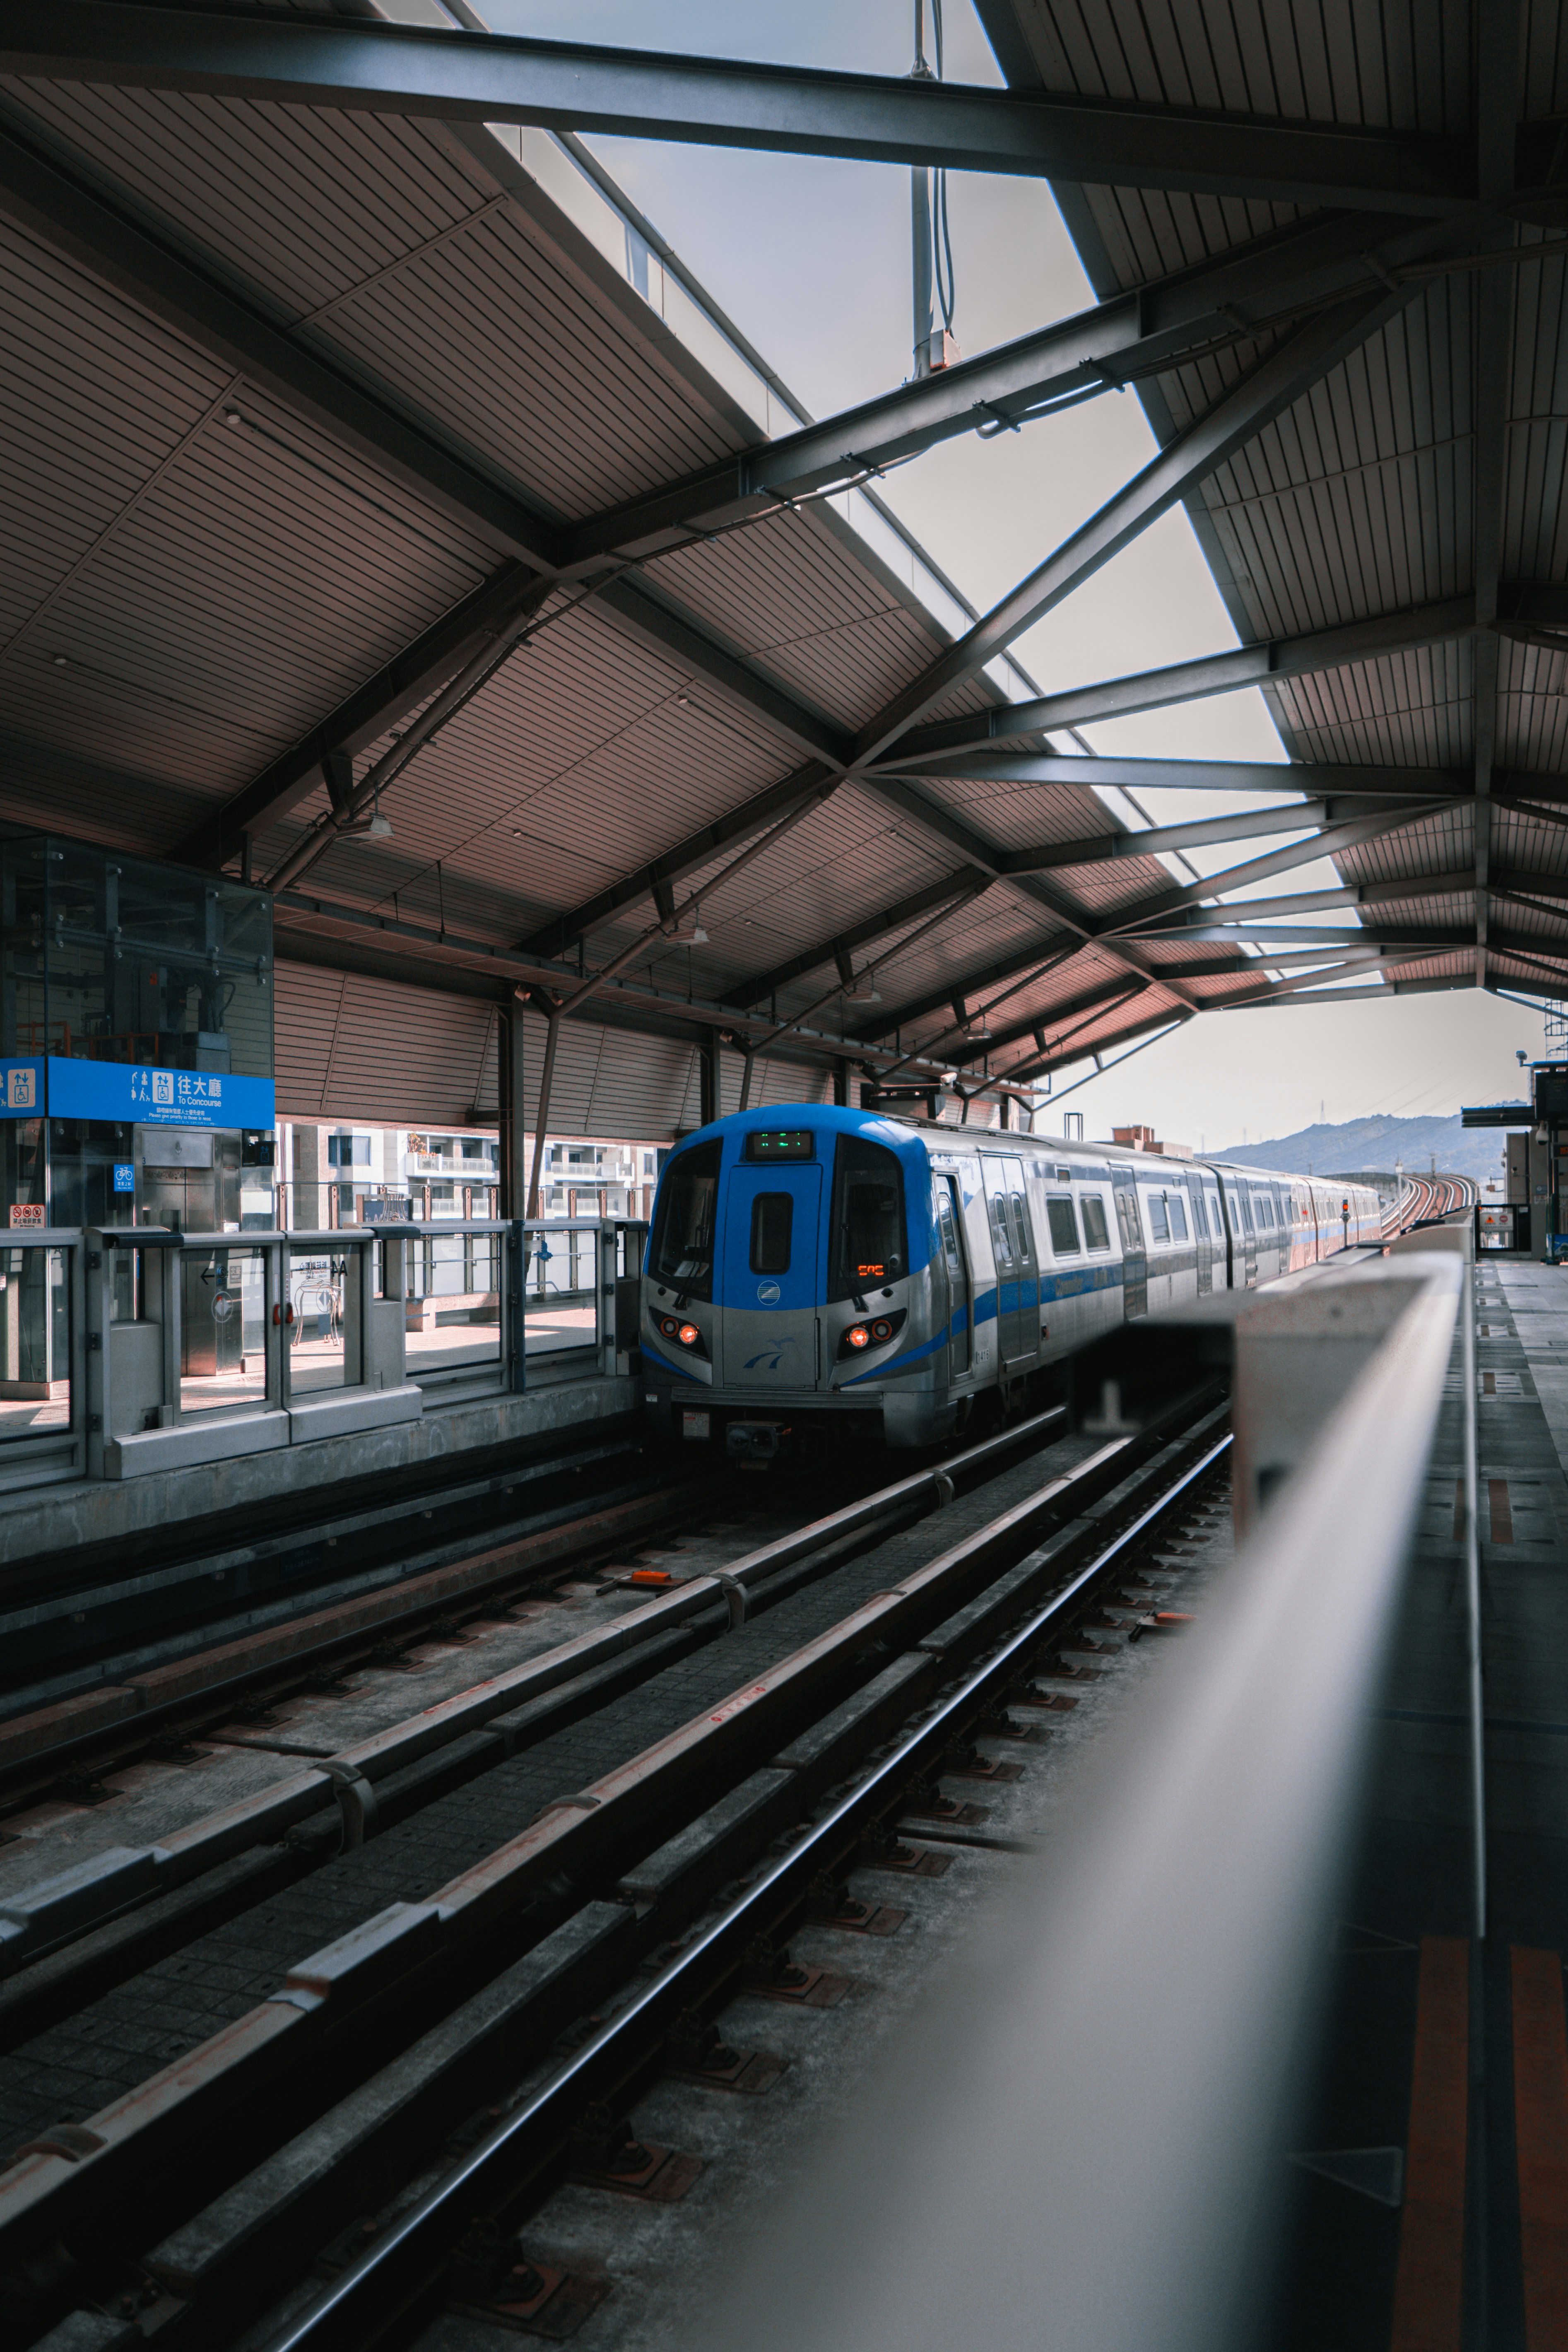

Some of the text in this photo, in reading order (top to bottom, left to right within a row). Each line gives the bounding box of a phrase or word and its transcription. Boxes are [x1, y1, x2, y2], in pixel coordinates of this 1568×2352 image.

[178, 1075, 222, 1097] 往大廳
[178, 1096, 222, 1107] To Concourse
